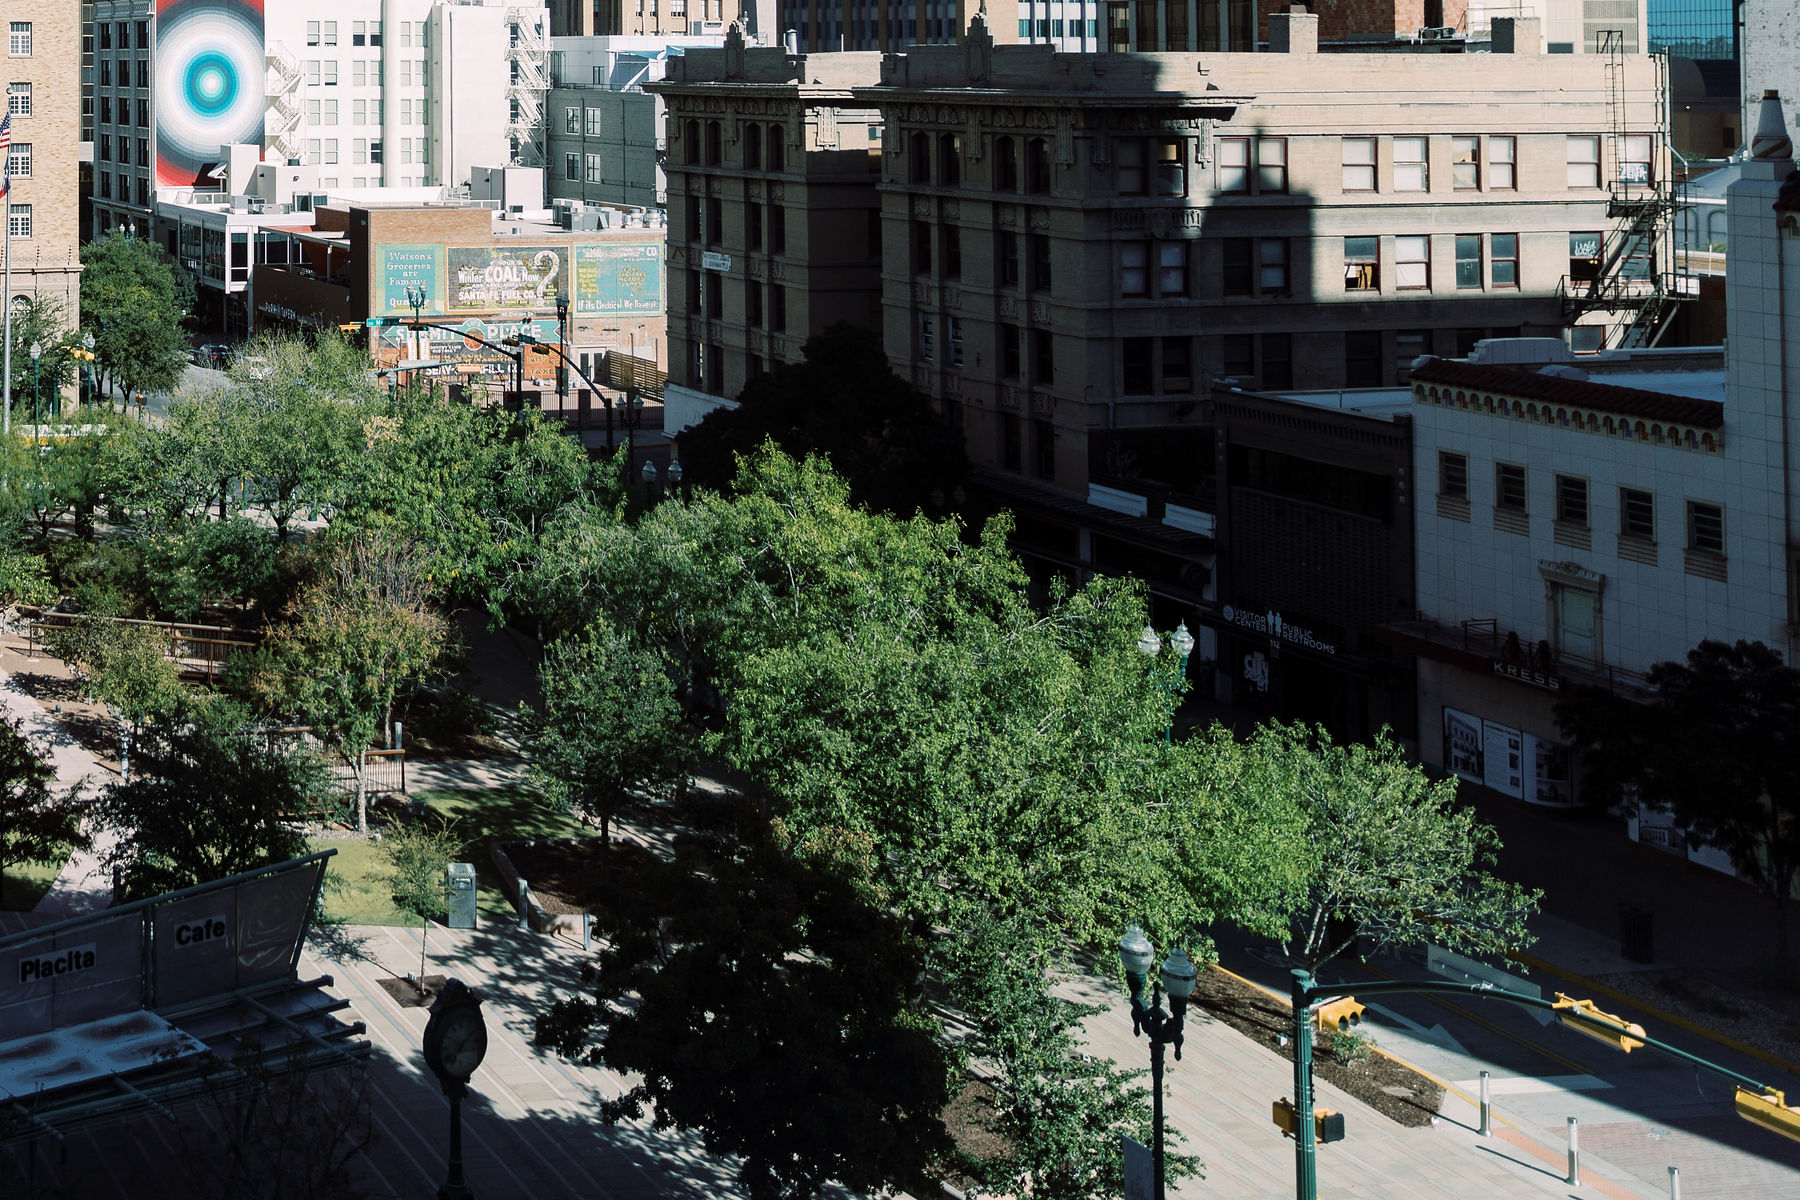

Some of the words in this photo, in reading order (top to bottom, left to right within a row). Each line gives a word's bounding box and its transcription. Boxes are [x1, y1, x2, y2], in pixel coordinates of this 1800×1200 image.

[389, 251, 433, 260] Watson's
[387, 262, 432, 270] Groceries
[389, 277, 426, 285] Famous
[457, 270, 484, 284] Winter
[485, 265, 521, 283] COAL
[458, 291, 486, 301] SANTA
[489, 291, 500, 300] FE
[502, 290, 522, 300] FUEL
[578, 299, 584, 310] If
[487, 324, 542, 339] PLACE
[1233, 608, 1266, 624] VISITOR
[1235, 616, 1267, 633] CENTER
[1282, 623, 1313, 640] PUBLIC
[1270, 640, 1280, 649] 112
[1282, 631, 1335, 655] RESTROOMS
[1493, 661, 1559, 689] KRESS
[20, 949, 95, 983] Placita
[175, 919, 226, 947] Cafe
